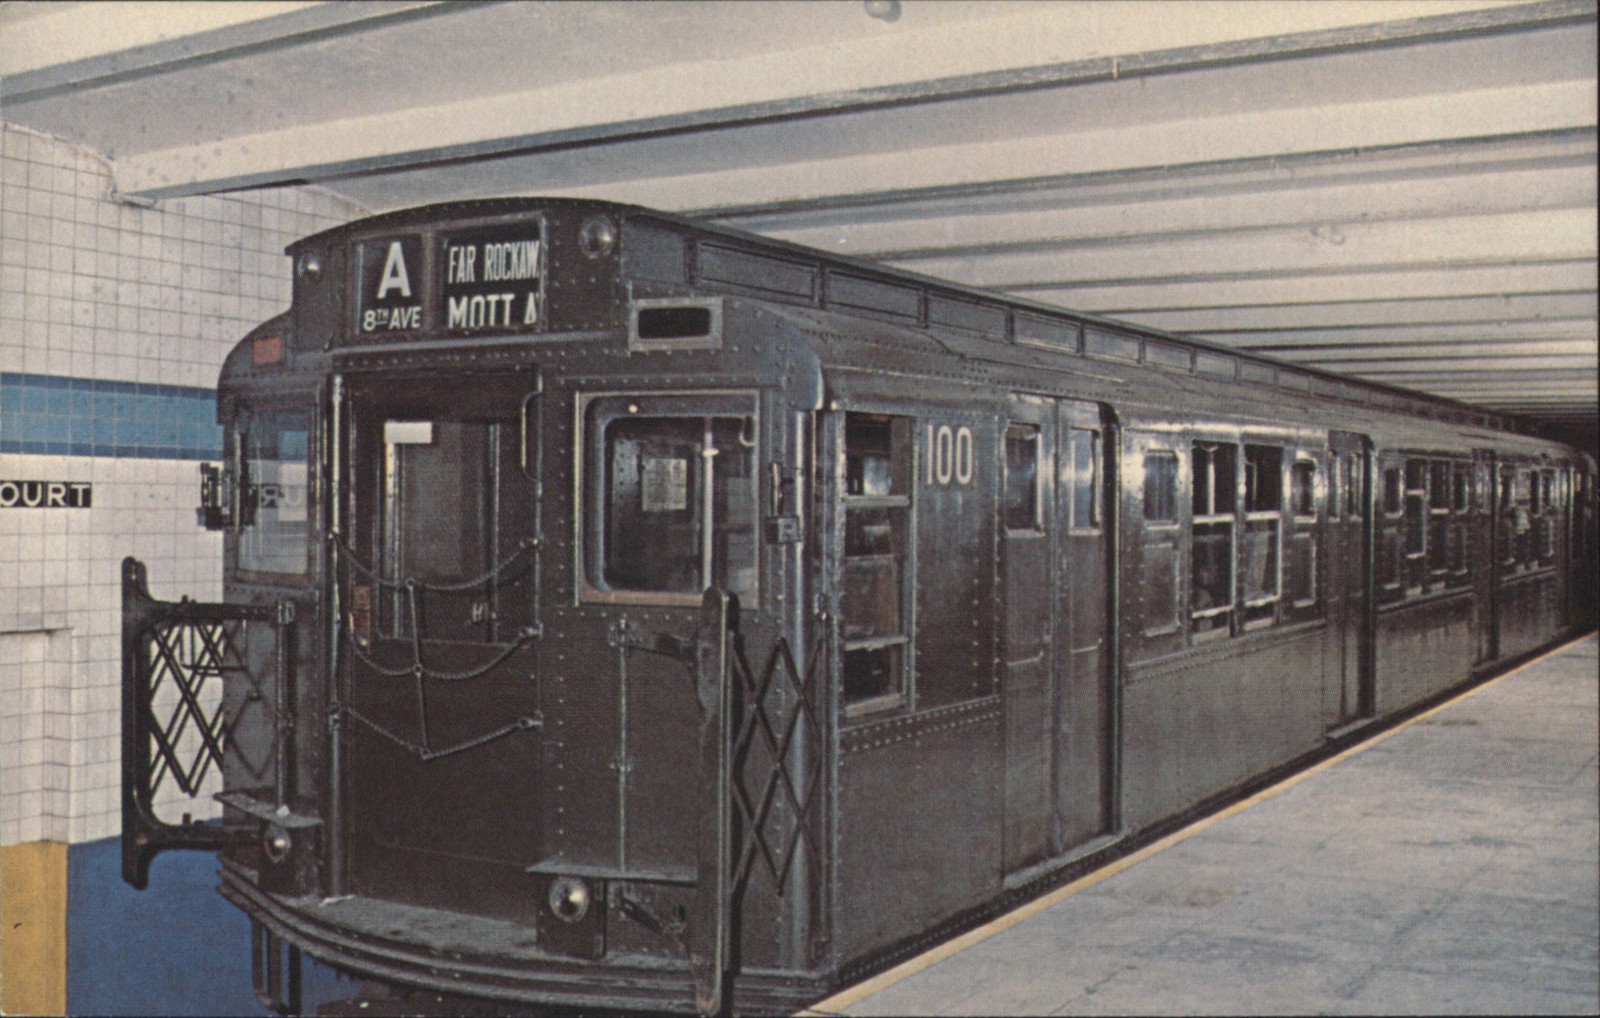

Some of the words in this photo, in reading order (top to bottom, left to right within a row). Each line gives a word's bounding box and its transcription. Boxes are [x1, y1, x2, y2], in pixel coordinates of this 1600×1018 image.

[377, 241, 411, 299] A
[449, 245, 476, 283] FAR
[484, 240, 540, 281] ROCKAW
[363, 309, 389, 331] 8TH
[389, 306, 422, 330] AVE
[449, 293, 515, 329] MOTT
[524, 292, 539, 324] A
[928, 425, 972, 485] 100
[0, 482, 91, 507] OURT
